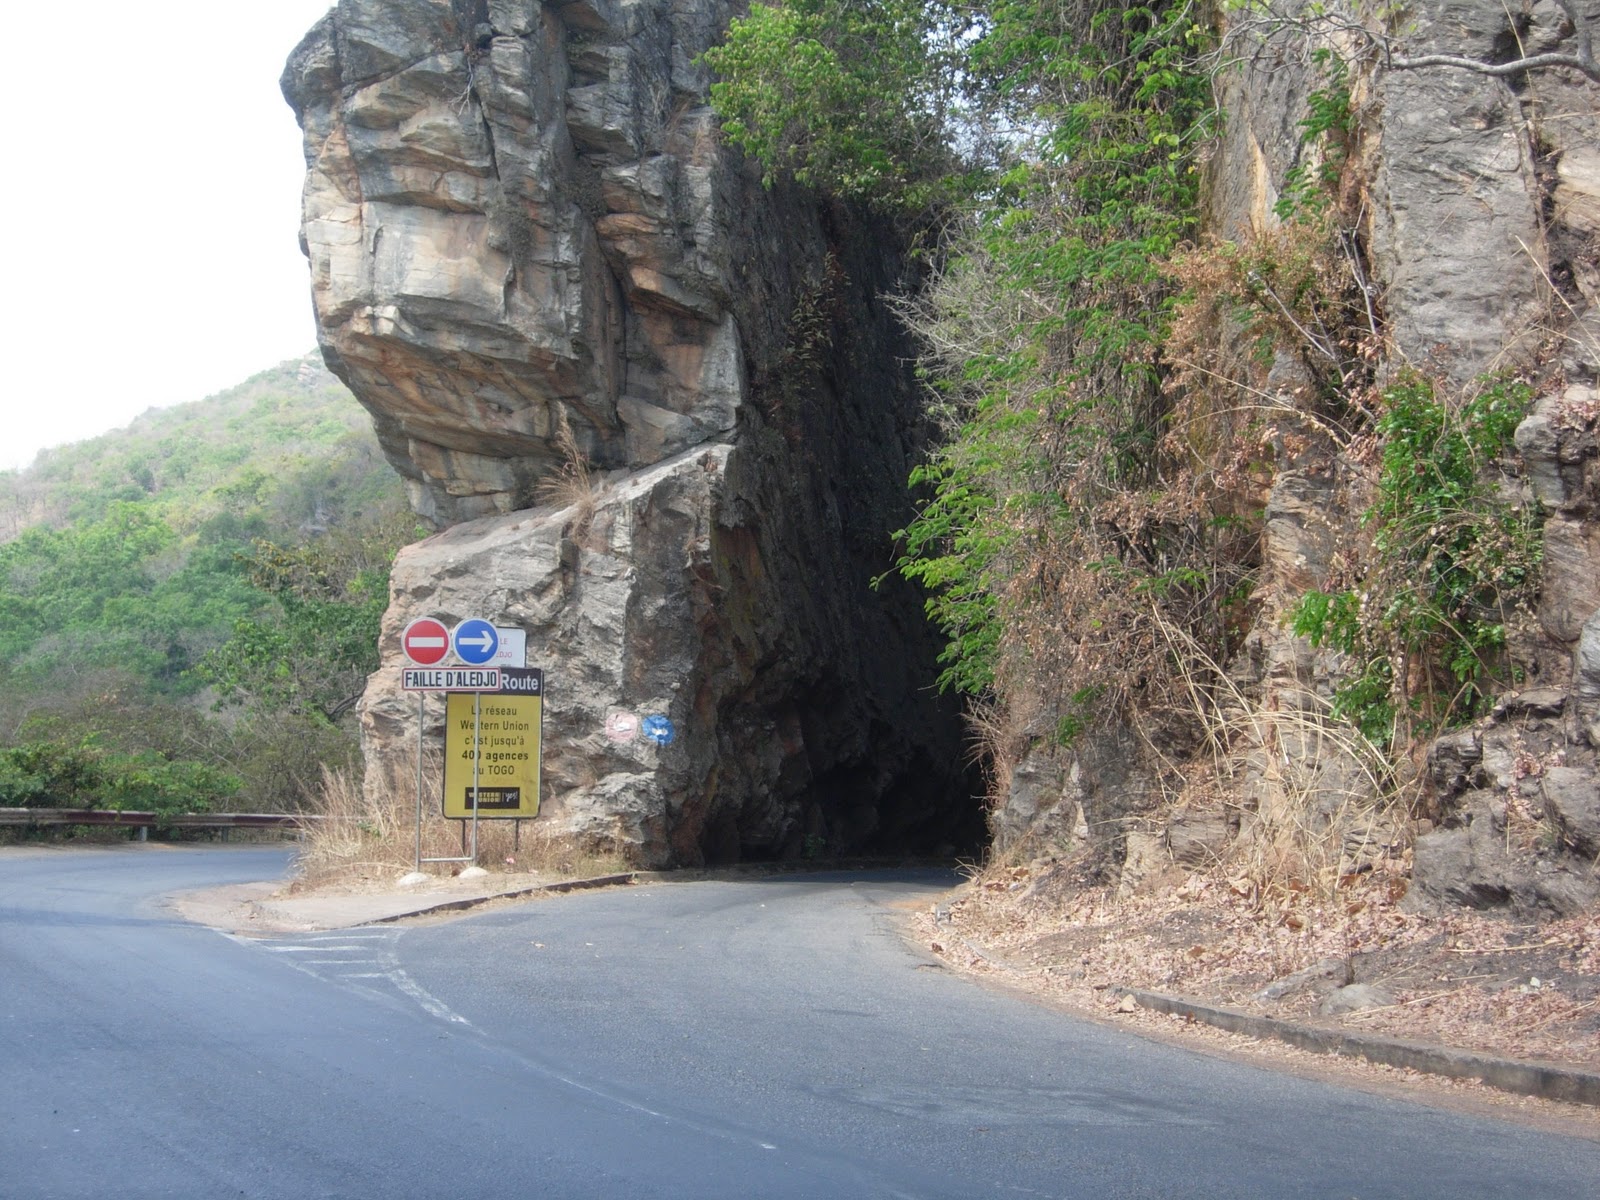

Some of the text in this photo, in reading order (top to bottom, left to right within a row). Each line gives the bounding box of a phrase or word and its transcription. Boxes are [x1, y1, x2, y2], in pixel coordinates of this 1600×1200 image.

[405, 671, 497, 687] FAILLE D'ALEDJO
[501, 673, 539, 690] Route
[485, 705, 517, 716] réseau
[460, 720, 529, 731] Wetern Union
[490, 735, 525, 748] jusqu'à
[485, 752, 529, 763] agences
[487, 765, 515, 775] TOGO
